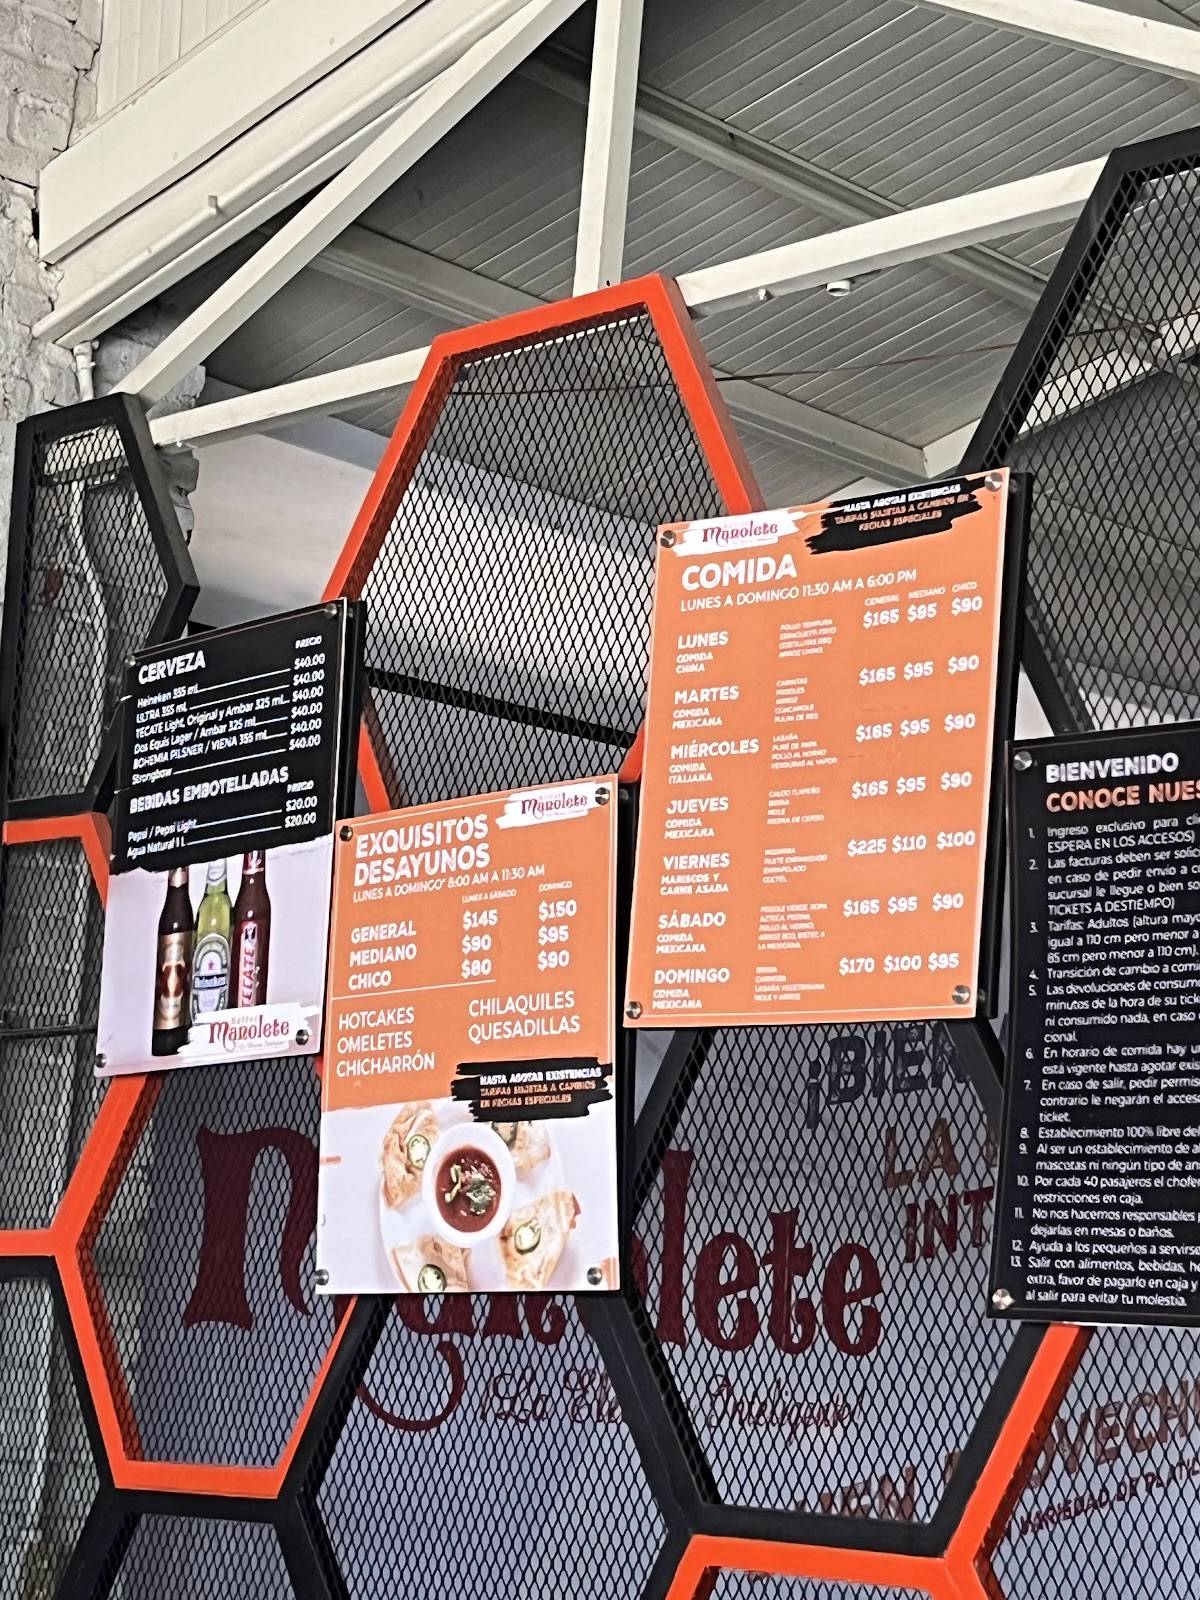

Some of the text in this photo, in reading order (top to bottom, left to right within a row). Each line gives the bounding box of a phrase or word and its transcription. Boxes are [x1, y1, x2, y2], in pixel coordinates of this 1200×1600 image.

[682, 554, 797, 591] COMIDA
[681, 597, 721, 612] LUNES
[724, 597, 733, 606] A
[737, 587, 799, 605] DOMINGO
[832, 581, 851, 594] AM
[855, 579, 864, 589] A
[868, 572, 895, 587] 6:00
[897, 569, 917, 583] PM
[863, 596, 983, 629] $165 $95 $90
[678, 631, 729, 650] LUNES
[138, 651, 206, 685] CERVEZA
[294, 653, 325, 670] $40.00
[859, 655, 980, 686] $165 $95 $90
[136, 709, 160, 723] ULTRA
[293, 669, 324, 686] $40.00
[674, 686, 740, 704] MARTES
[136, 722, 163, 739] TECATE
[219, 710, 225, 721] y
[292, 685, 323, 702] $40.00
[194, 727, 199, 741] /
[291, 702, 323, 719] $40.00
[205, 740, 210, 754] /
[291, 718, 322, 734] $40.00
[856, 713, 976, 743] $165 $95 $90
[289, 734, 320, 750] $40.00
[671, 739, 759, 760] MIÉRCOLES
[1046, 752, 1179, 783] BIENVENIDO
[130, 766, 289, 814] BEBIDAS EMBOTELLADAS
[852, 771, 972, 800] $165 $95 $90
[286, 796, 317, 812] $20.00
[667, 797, 728, 814] JUEVES
[1046, 785, 1140, 812] CONOCE
[285, 812, 317, 829] $20.00
[1047, 817, 1178, 839] Ingreso para
[356, 814, 488, 859] EXQUISITOS
[848, 831, 976, 858] $225 $110 $100
[1048, 833, 1135, 853] ESPERA EN LOS
[354, 843, 490, 887] DESAYUNOS
[663, 853, 729, 870] VIERNES
[1048, 850, 1171, 869] Las facturas deben ser
[353, 864, 545, 903] LUNES A 8:00 AM A 11:30 AM
[713, 873, 719, 882] Y
[1048, 866, 1187, 885] en caso de pedir a
[462, 900, 577, 931] $145 $150
[843, 893, 964, 918] $165 $95 $90
[1048, 901, 1102, 916] TICKETS A
[658, 910, 726, 929] SÁBADO
[351, 921, 416, 944] GENERAL
[1047, 931, 1189, 950] igual a cm pero menor
[350, 925, 569, 967] MEDIANO $90 $95
[349, 950, 569, 990] CHICO $80 $90
[655, 968, 730, 984] DOMINGO
[838, 952, 959, 976] $170 $100 $95
[338, 991, 575, 1030] HOTCAKES CHILAQUILES
[209, 1015, 289, 1052] Manolete
[337, 1016, 580, 1054] OMELETES QUESADILLAS
[1102, 1045, 1118, 1056] de
[336, 1050, 435, 1078] CHICHARRÓN
[1168, 1159, 1182, 1170] de
[1034, 1175, 1164, 1187] Por cada el
[1029, 1241, 1089, 1254] Ayuda los
[1061, 1292, 1133, 1305] para tu
